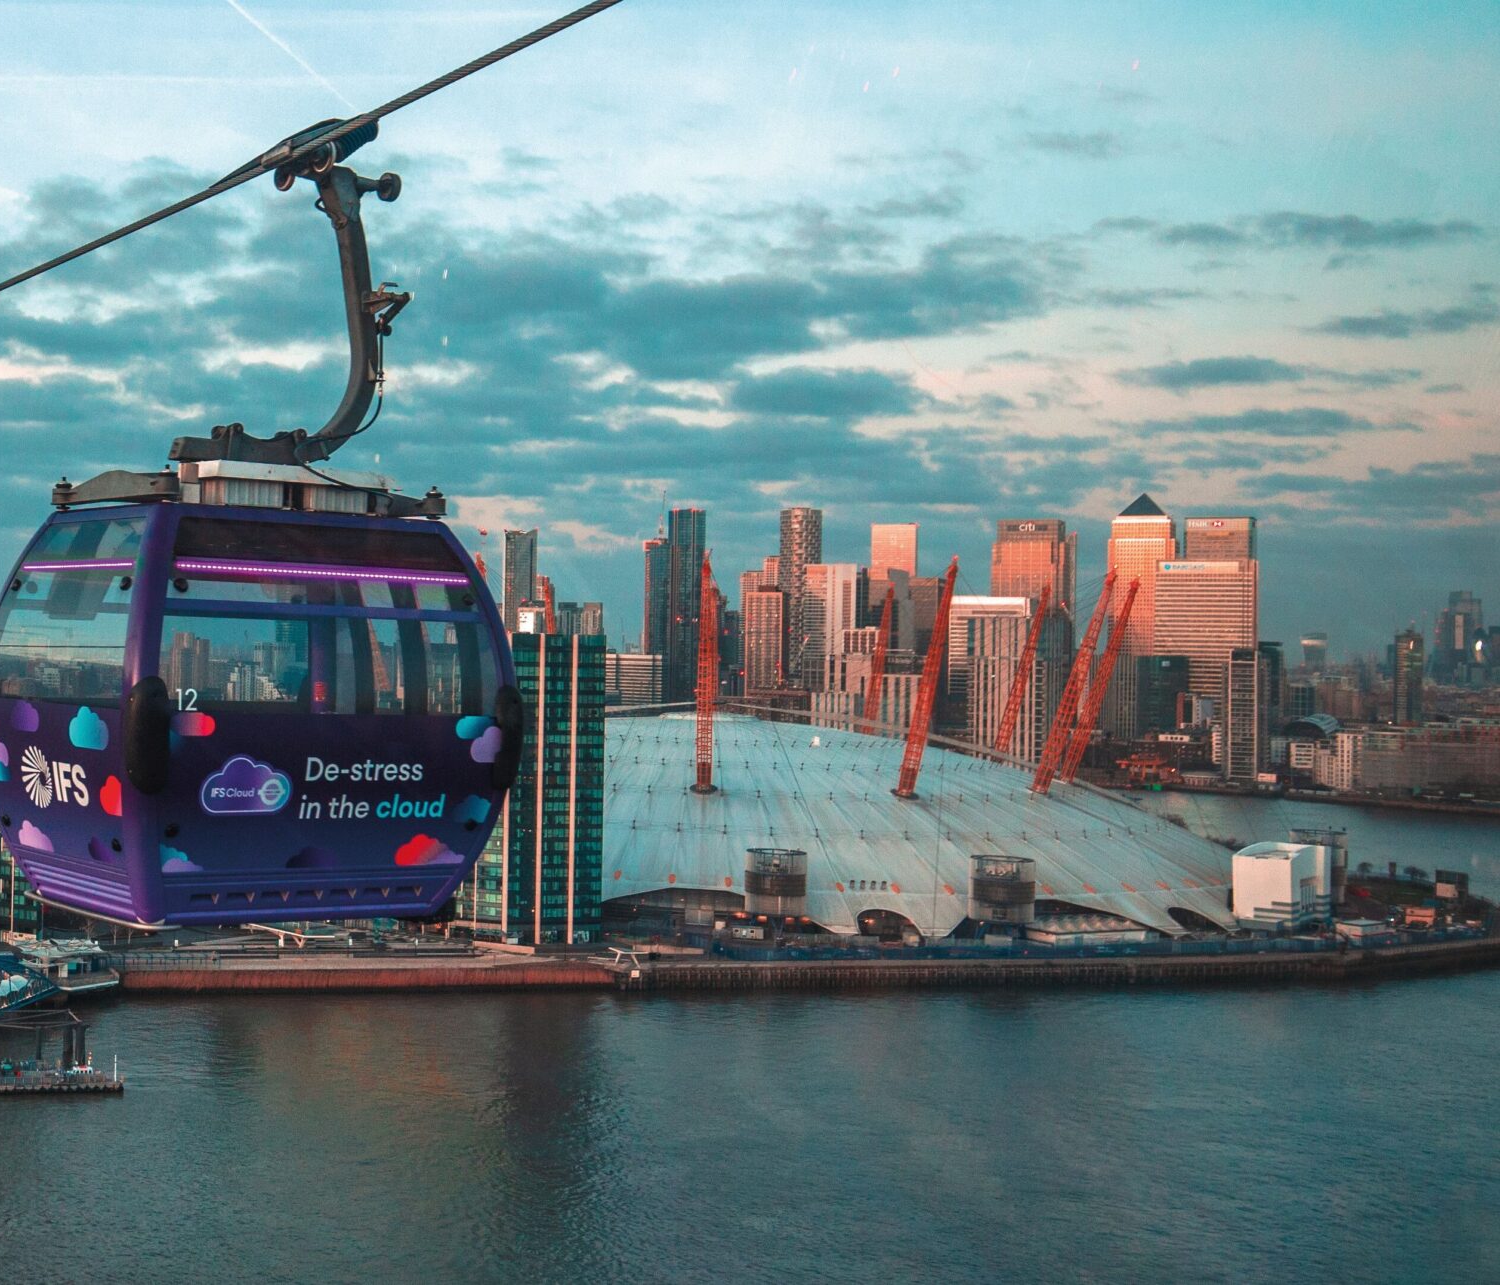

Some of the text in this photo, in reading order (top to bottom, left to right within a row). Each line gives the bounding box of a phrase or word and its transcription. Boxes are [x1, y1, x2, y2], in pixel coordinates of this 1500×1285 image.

[1018, 522, 1035, 531] citi
[175, 688, 198, 711] 12
[305, 756, 424, 782] De-stress
[52, 760, 90, 807] IFS
[211, 787, 226, 798] IFS
[226, 787, 255, 798] Cloud
[299, 793, 446, 819] in the cloud
